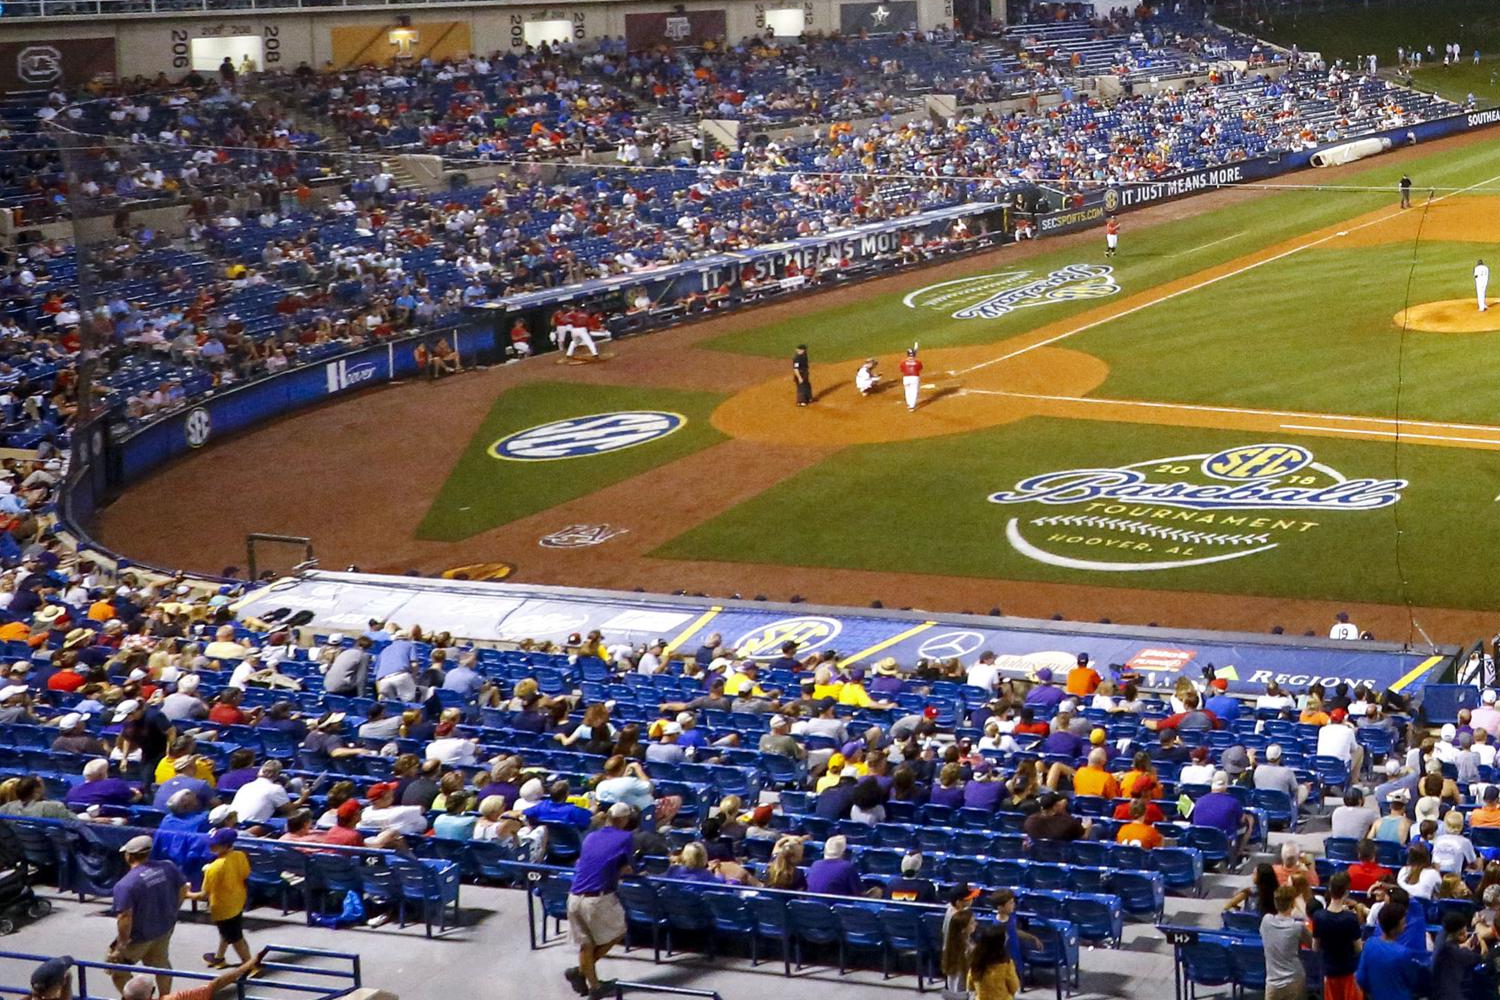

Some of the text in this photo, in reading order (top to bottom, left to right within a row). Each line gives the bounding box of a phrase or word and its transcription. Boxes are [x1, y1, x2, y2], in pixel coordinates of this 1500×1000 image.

[510, 14, 522, 48] 208
[575, 12, 585, 39] 210
[171, 29, 188, 68] 206
[265, 26, 280, 63] 208
[1121, 166, 1244, 206] IT JUST MEANS MORE.
[1041, 207, 1104, 231] SECSPORTS.COM
[701, 267, 721, 291] IT
[728, 257, 777, 288] JST
[325, 359, 377, 394] Hoover
[186, 408, 210, 446] SEC
[506, 413, 671, 457] SEC
[1154, 464, 1315, 485] 20 18
[1213, 447, 1302, 479] SEC
[988, 468, 1409, 510] Baseball
[1083, 502, 1320, 533] TOURNAMENT
[1047, 533, 1195, 556] HOOVER, AL
[1338, 628, 1349, 640] 19
[1247, 670, 1376, 689] REGIONS
